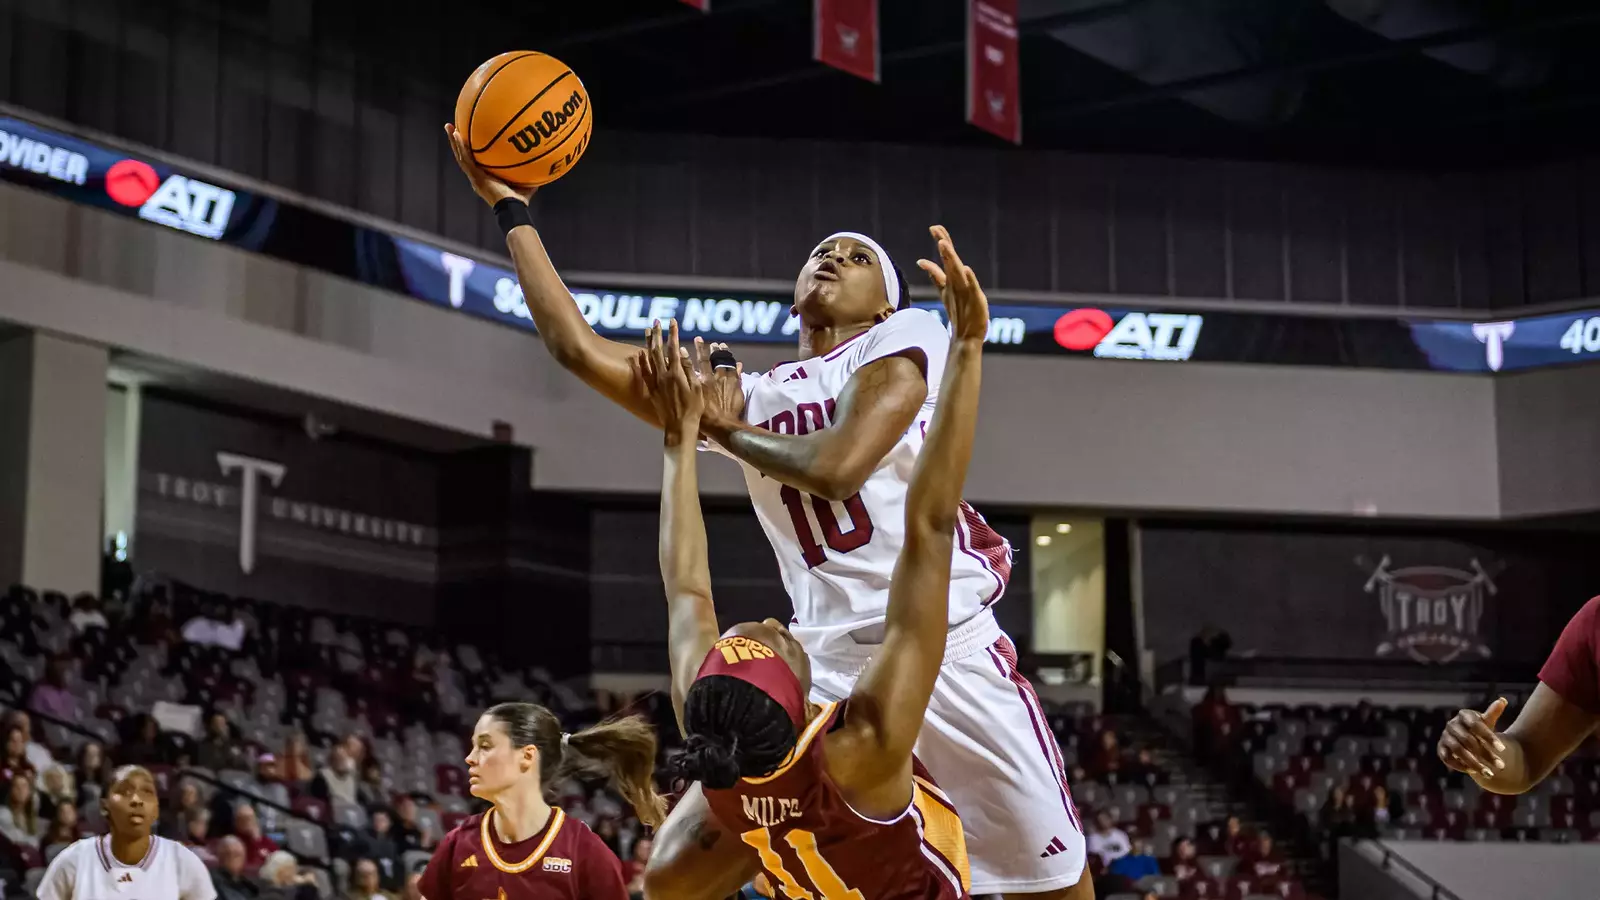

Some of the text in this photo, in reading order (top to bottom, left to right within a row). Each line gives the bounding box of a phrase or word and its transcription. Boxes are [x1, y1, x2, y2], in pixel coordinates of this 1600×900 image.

[508, 90, 583, 153] Wilson
[139, 174, 235, 240] ATI
[494, 278, 680, 331] SCDULE
[682, 298, 781, 335] NOW
[1093, 312, 1203, 361] ATI
[780, 483, 874, 570] 10
[1396, 591, 1466, 631] TROY
[542, 857, 572, 873] SBC
[741, 826, 866, 900] 11
